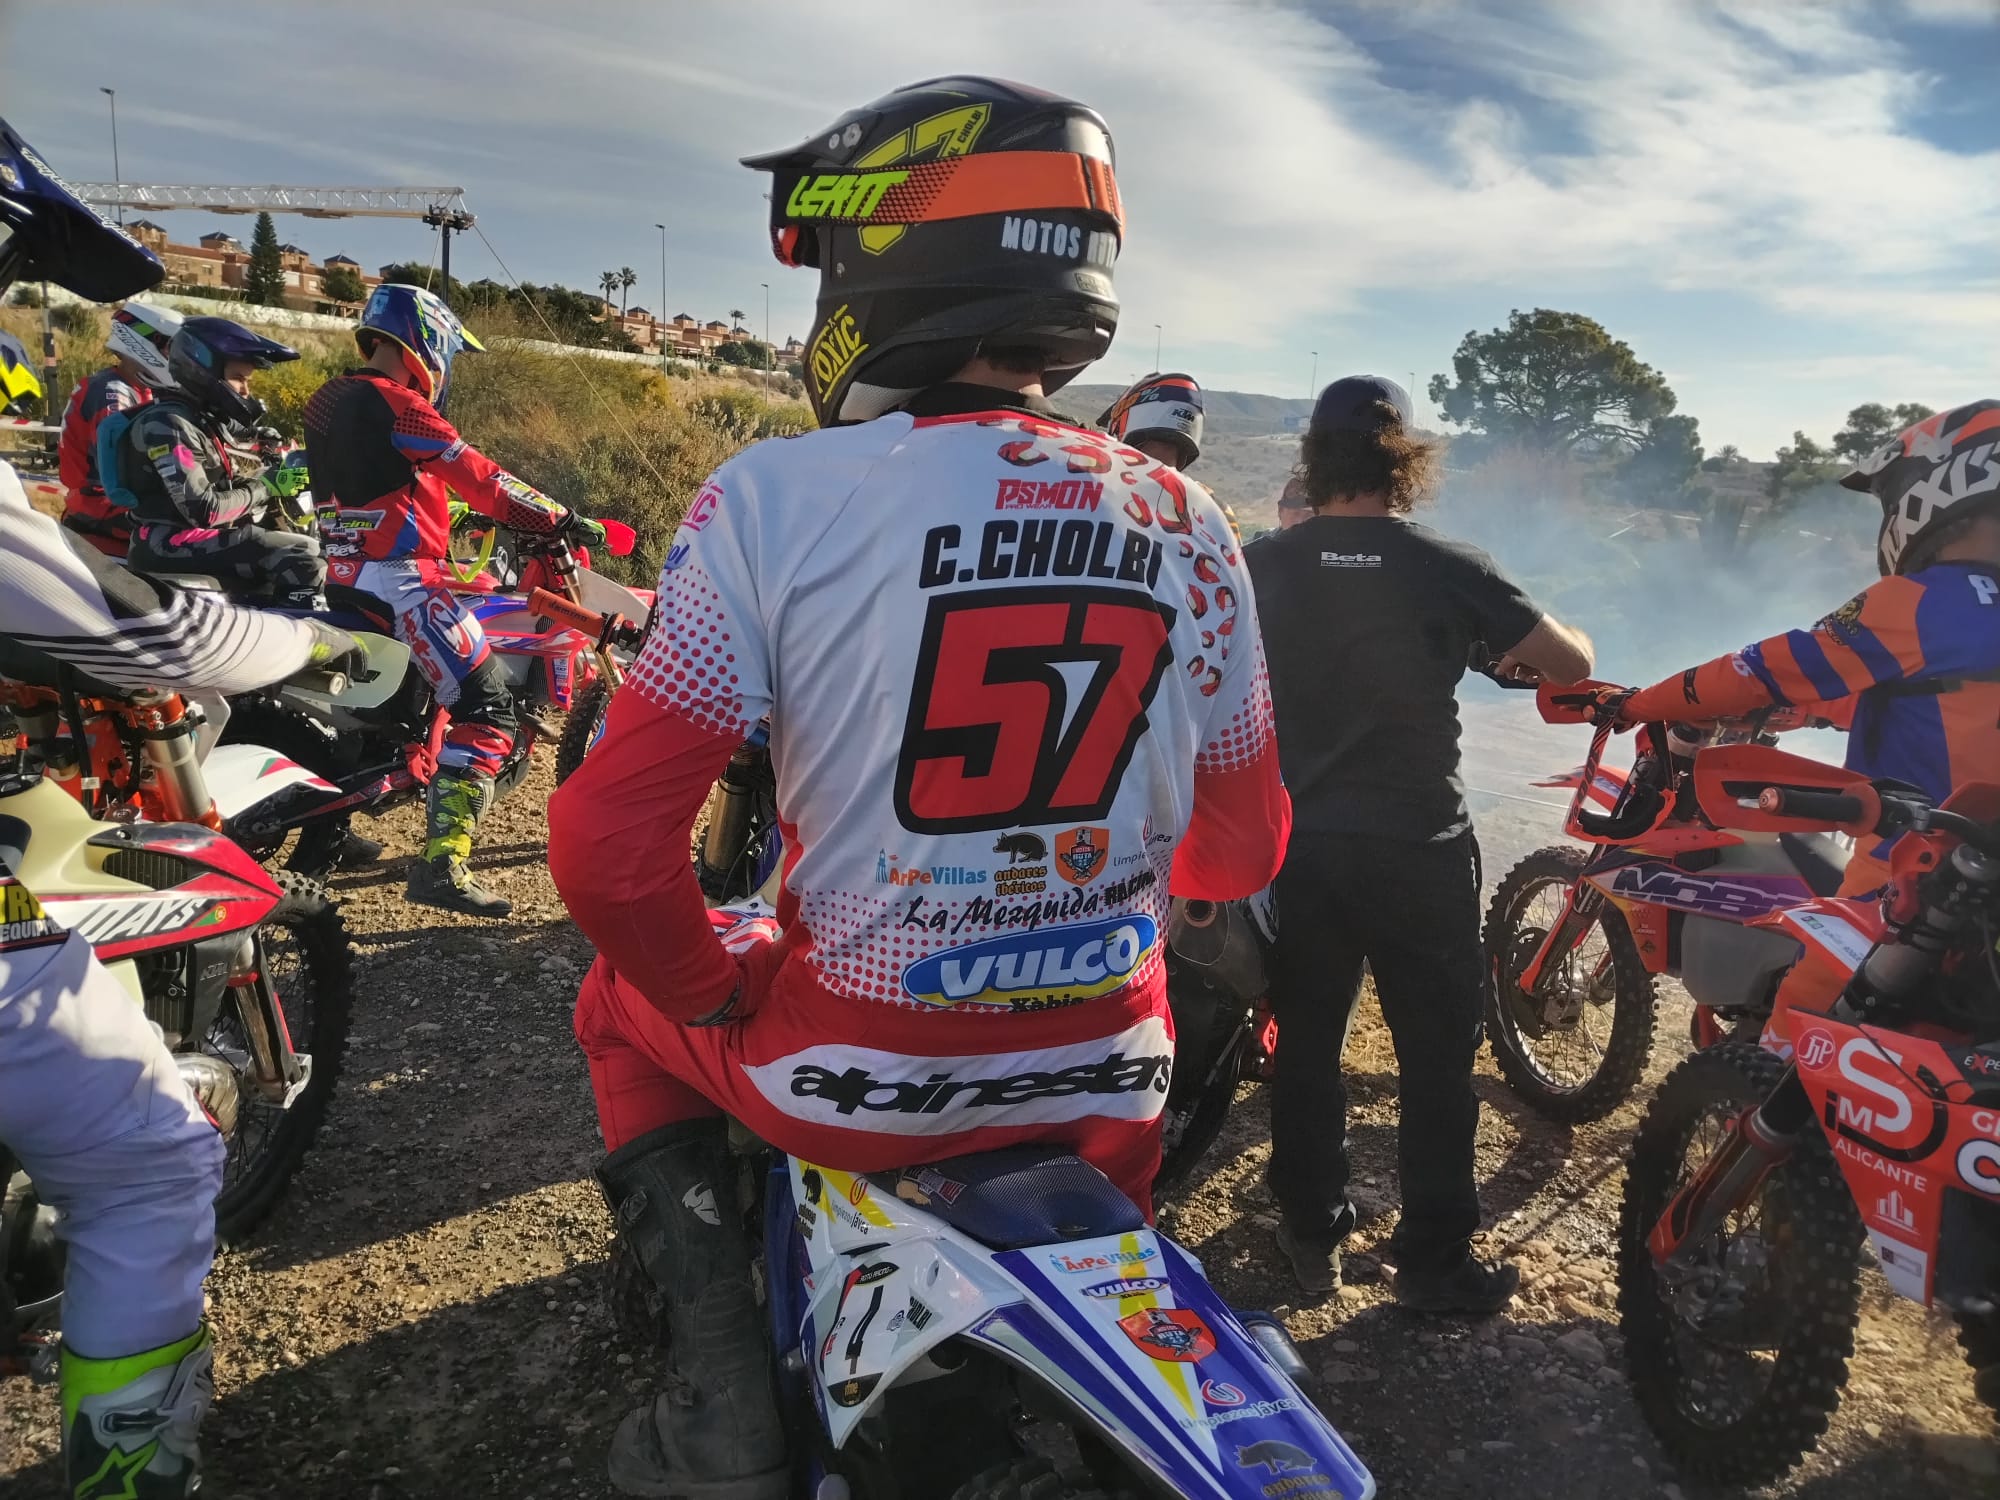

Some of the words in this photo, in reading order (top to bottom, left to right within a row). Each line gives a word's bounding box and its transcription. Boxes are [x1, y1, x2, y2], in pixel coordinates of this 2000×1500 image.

[957, 109, 984, 144] CHOLBI
[785, 170, 911, 218] LEATT
[1001, 215, 1081, 259] MOTOS
[919, 519, 1163, 590] C.CHOLBI
[1321, 551, 1382, 562] Beta
[893, 584, 1178, 835] 57
[889, 866, 987, 887] ArPeVillas
[902, 895, 949, 931] La
[950, 886, 1100, 936] Mezquida
[940, 924, 1141, 998] VULCO
[790, 1052, 1172, 1115] alpinestars
[1835, 1138, 1928, 1193] ALICANTE
[1065, 1247, 1155, 1271] ArPeVillas
[1088, 1278, 1161, 1298] VULCO
